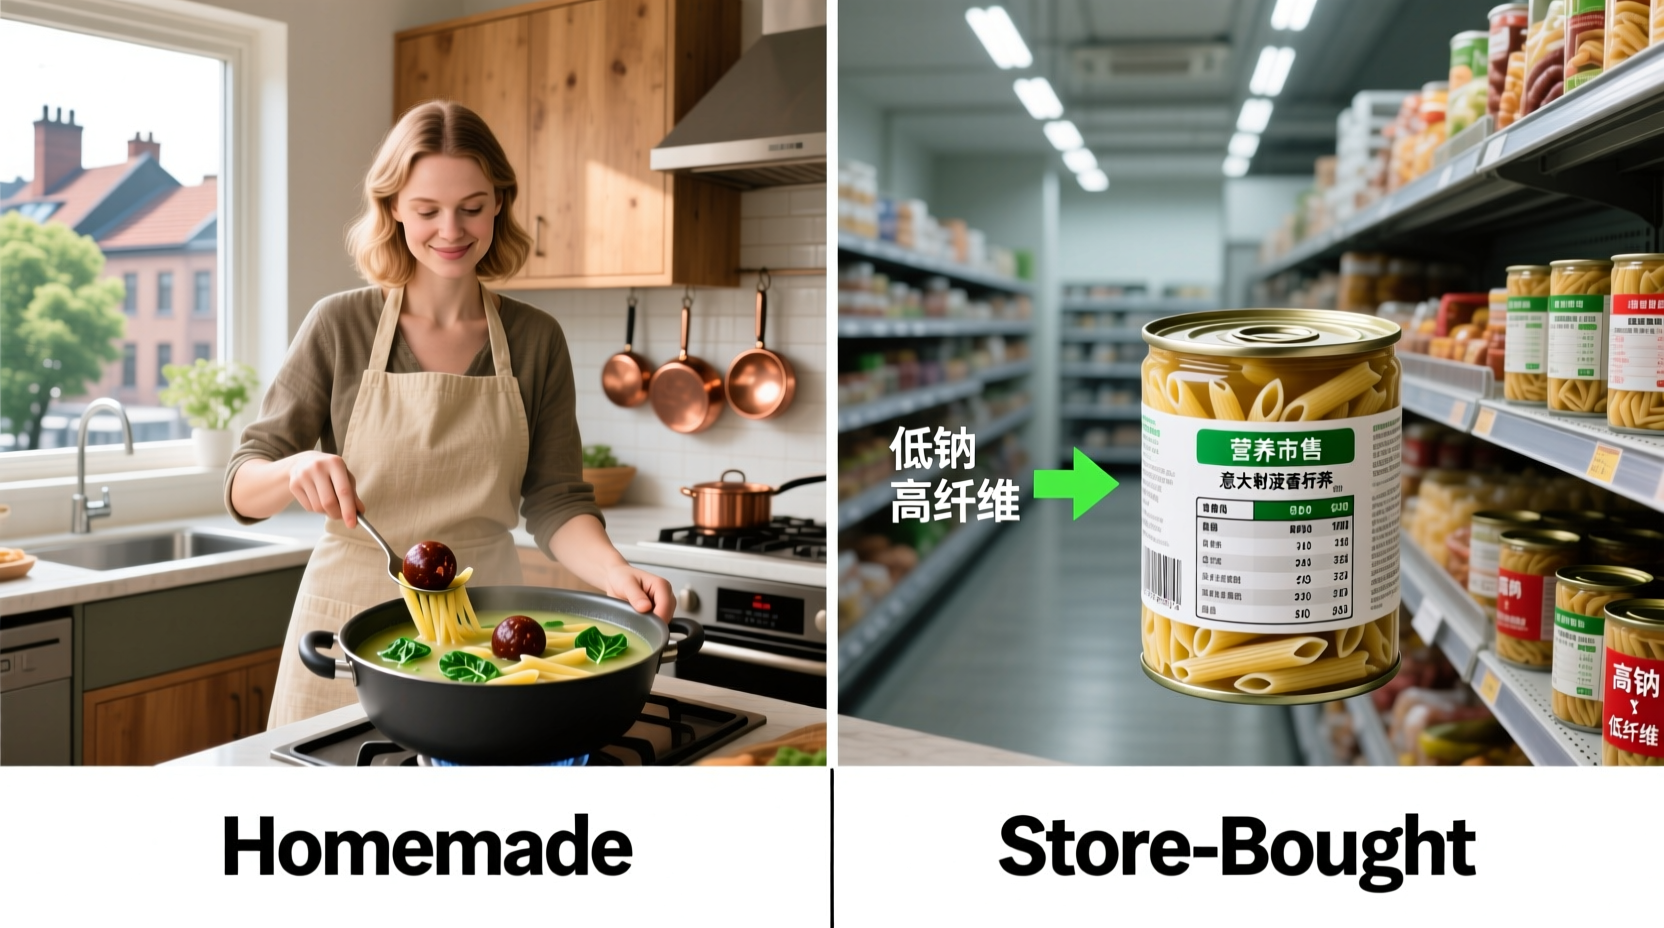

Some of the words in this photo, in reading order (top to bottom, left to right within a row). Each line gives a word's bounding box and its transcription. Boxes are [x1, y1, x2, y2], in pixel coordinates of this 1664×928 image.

[1230, 437, 1322, 463] 营养市售
[1613, 662, 1660, 698] 高钠
[1608, 714, 1660, 747] 低纤维
